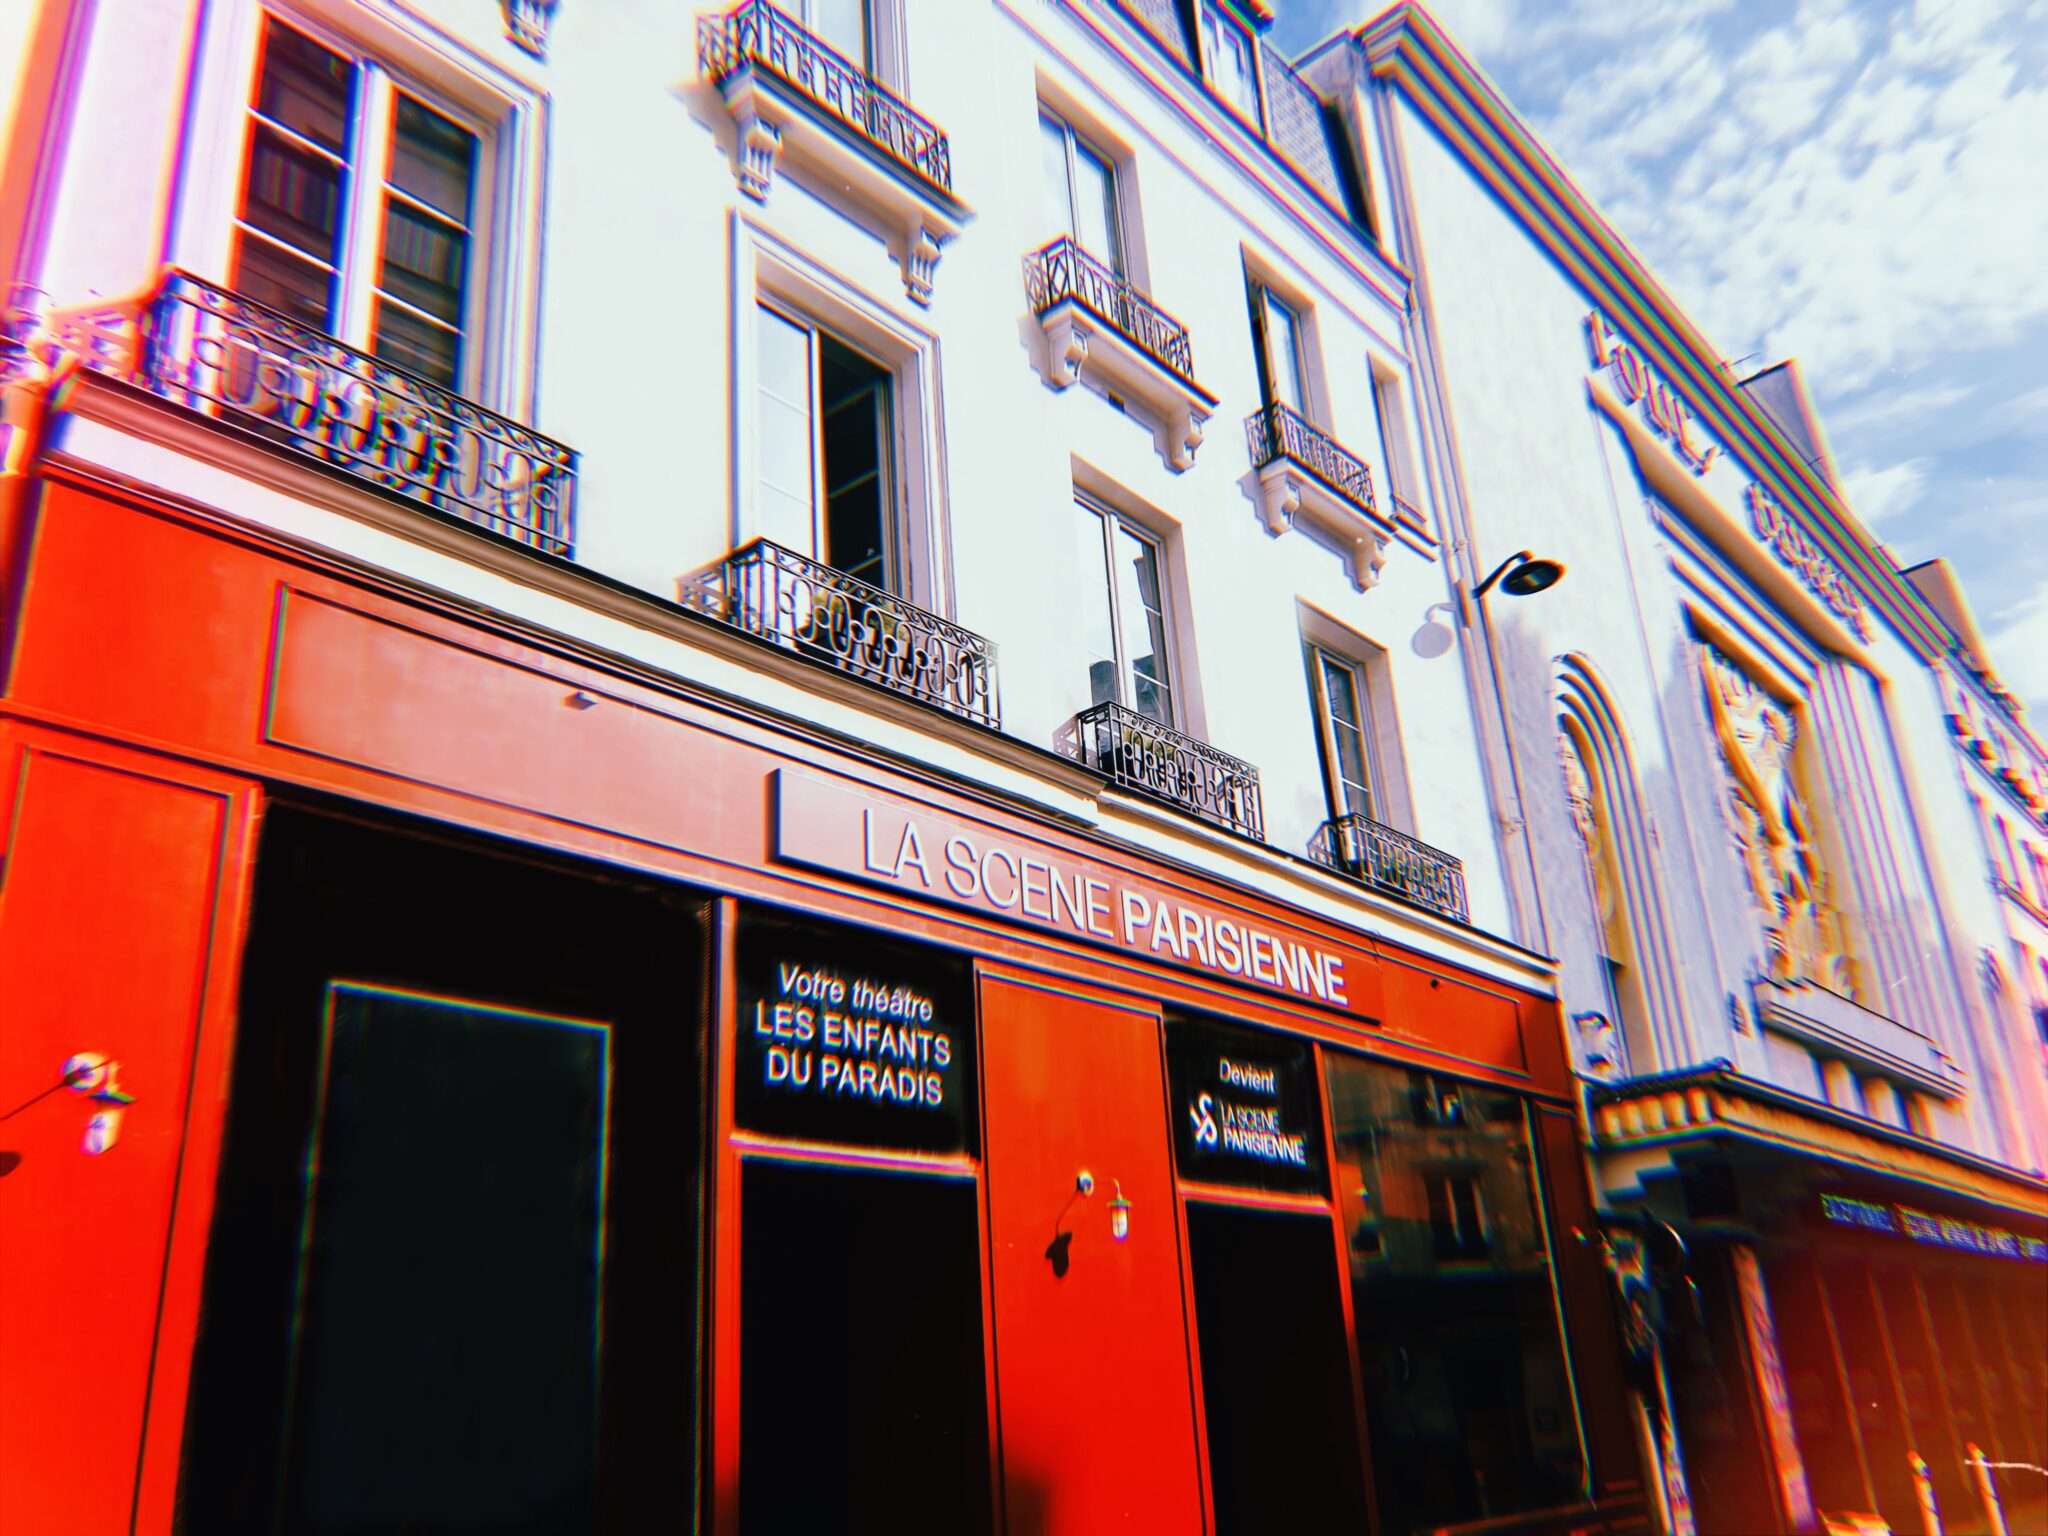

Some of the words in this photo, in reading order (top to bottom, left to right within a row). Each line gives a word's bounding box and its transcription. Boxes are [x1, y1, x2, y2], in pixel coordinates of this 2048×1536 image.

[863, 808, 931, 887] LA
[944, 836, 1113, 939] SCENE
[1121, 888, 1348, 1006] PARISIENNE
[779, 960, 847, 1005] Votre
[852, 978, 934, 1023] théâtre
[755, 998, 815, 1042] LES
[821, 1011, 951, 1068] ENFANTS
[766, 1044, 812, 1086] DU
[820, 1053, 943, 1107] PARADIS
[1219, 1056, 1276, 1096] Devient
[1219, 1100, 1236, 1126] LA
[1236, 1104, 1281, 1135] SCENE
[1222, 1124, 1308, 1168] PARISIENNE
